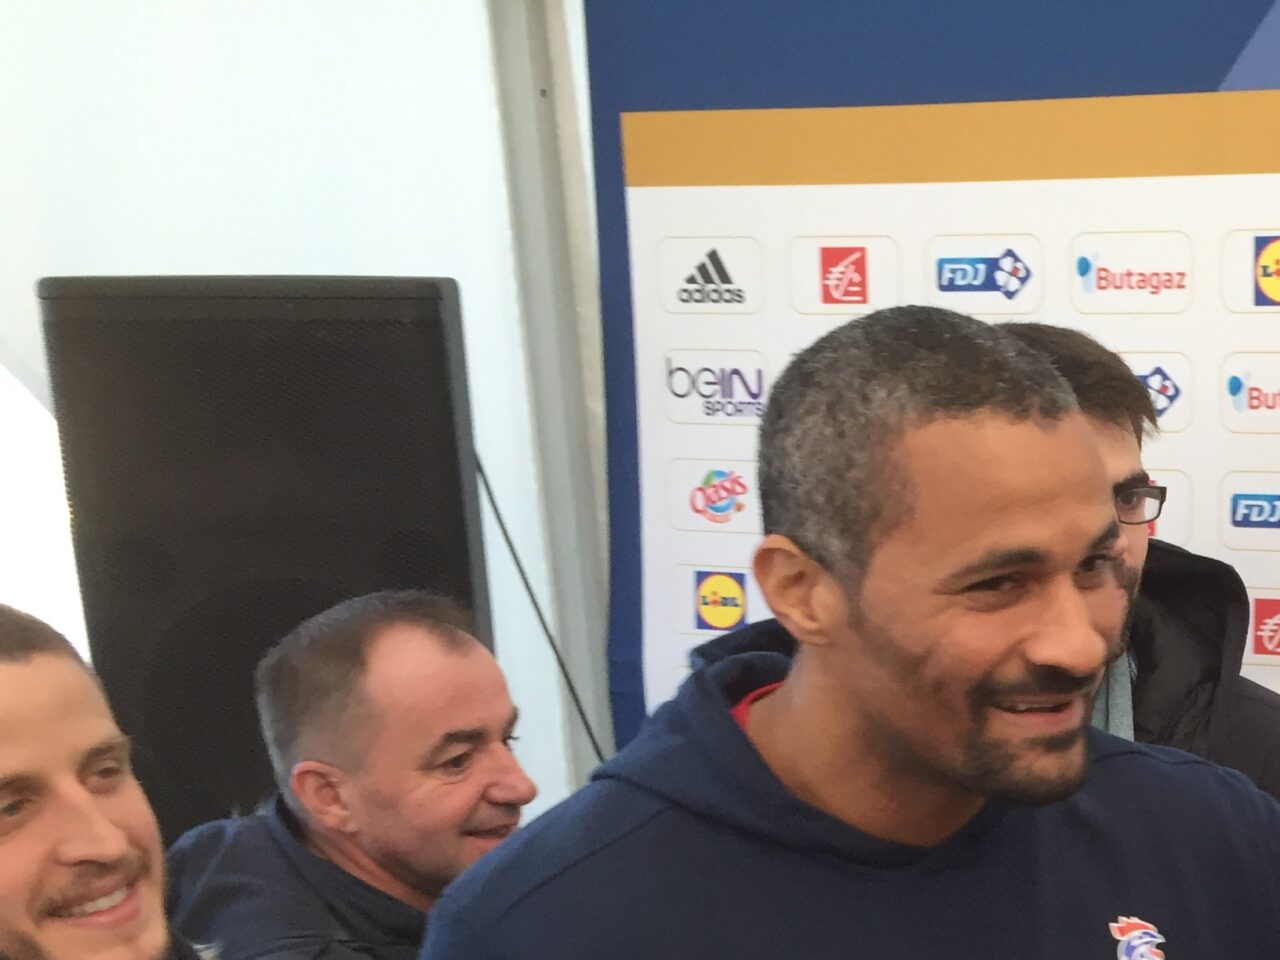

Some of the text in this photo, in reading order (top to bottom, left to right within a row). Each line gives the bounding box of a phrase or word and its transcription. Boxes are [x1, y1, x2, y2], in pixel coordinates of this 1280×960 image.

[940, 263, 987, 287] FDJ
[1096, 266, 1187, 295] Butagaz
[678, 284, 746, 304] adidas
[689, 470, 749, 511] Oasis
